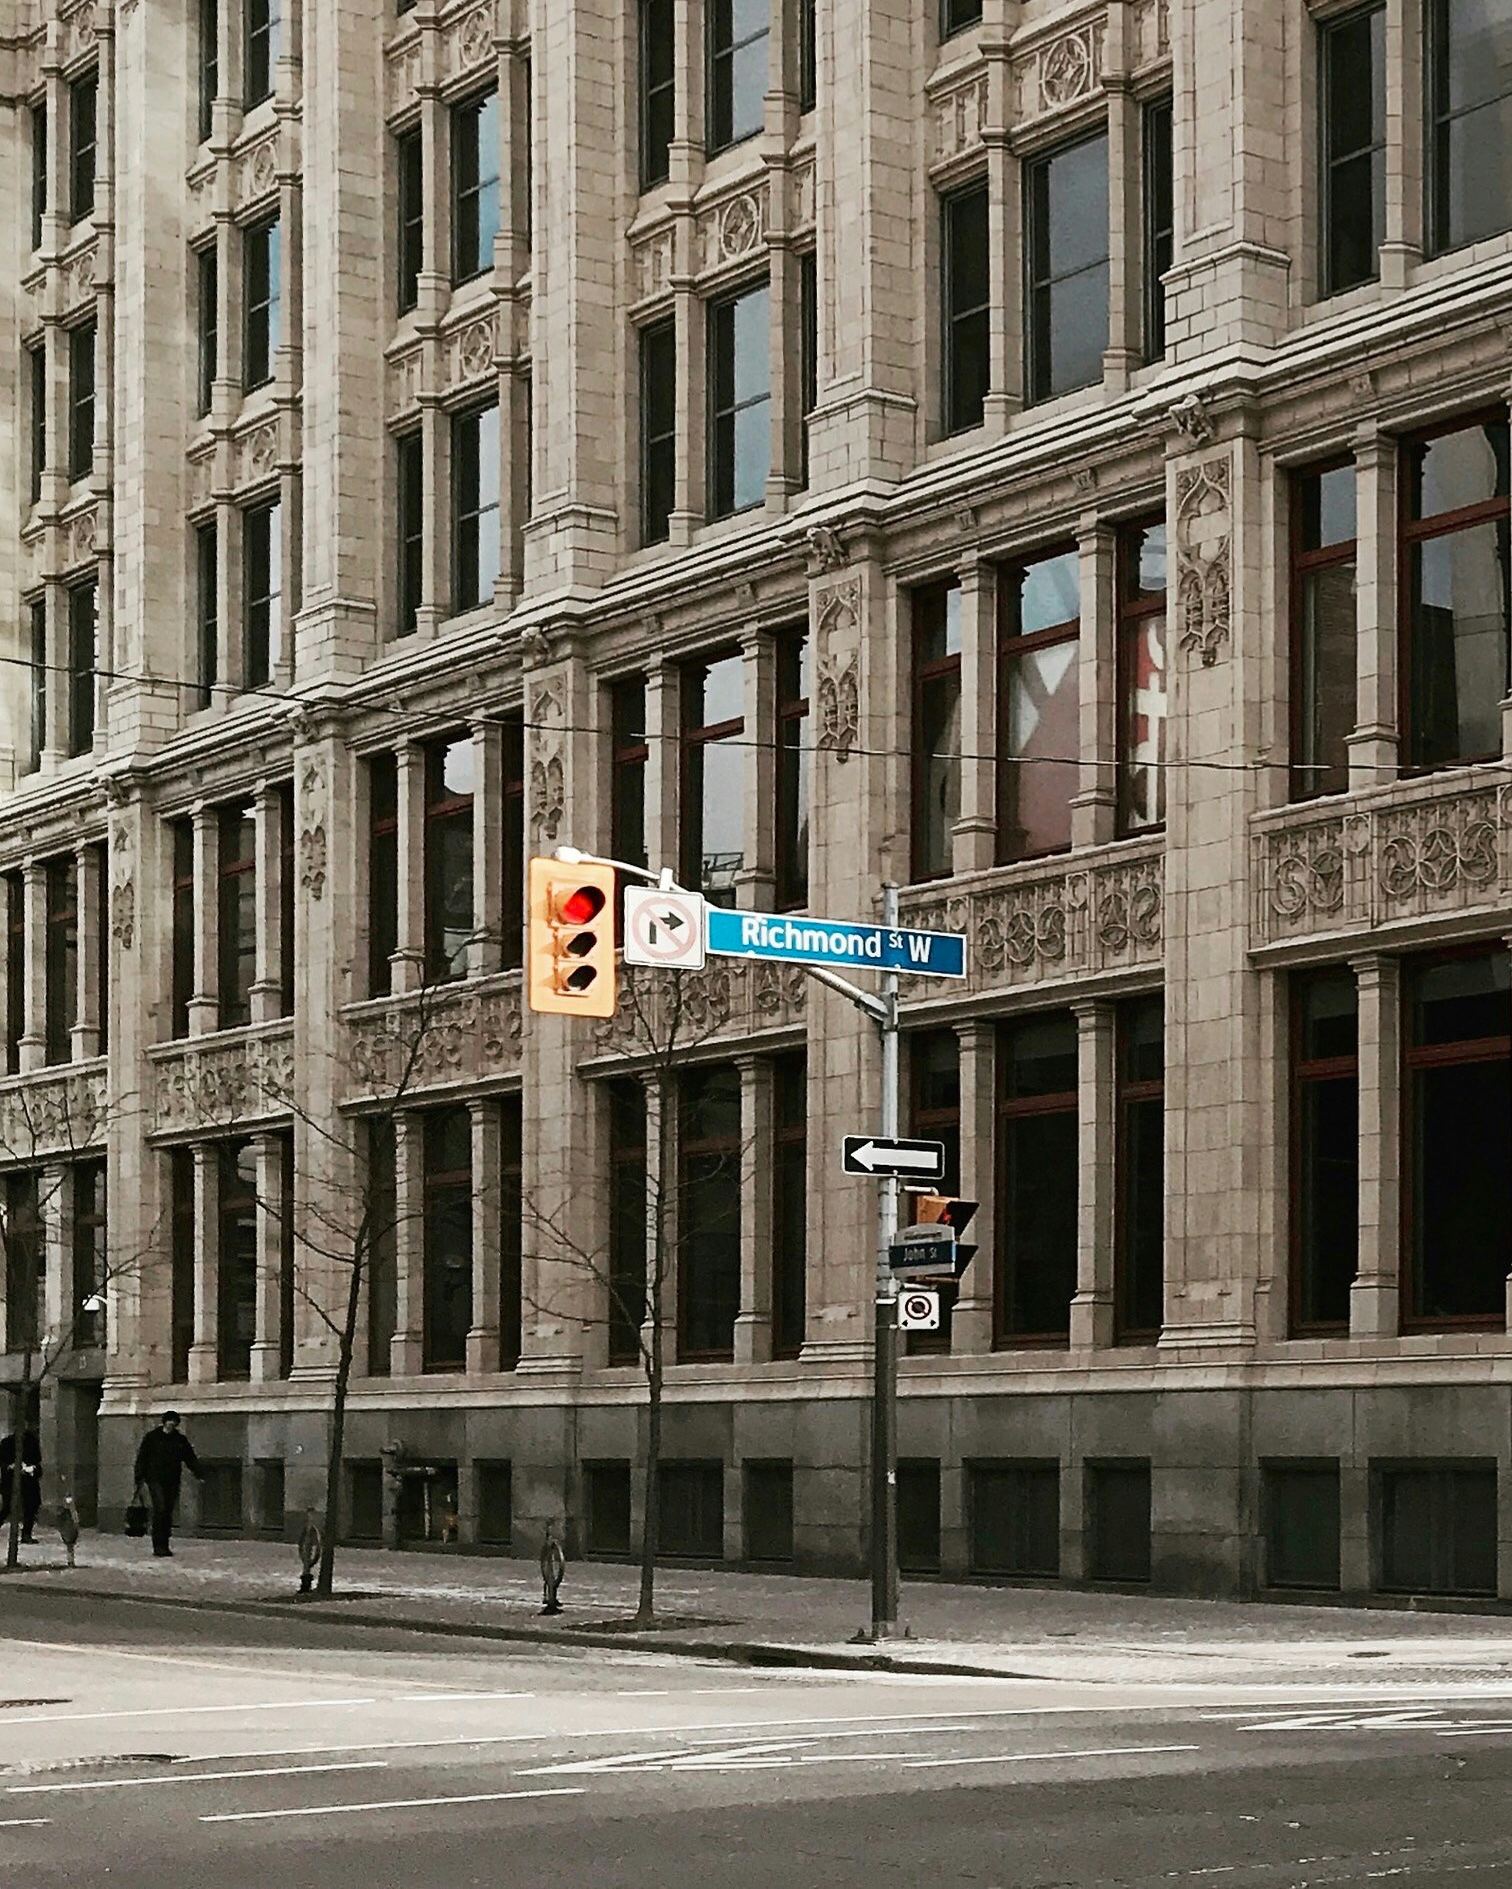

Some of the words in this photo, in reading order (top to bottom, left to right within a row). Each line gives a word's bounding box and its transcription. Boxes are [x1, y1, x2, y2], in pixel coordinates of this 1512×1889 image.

[741, 917, 881, 957] Richmond
[889, 933, 903, 949] St
[908, 935, 932, 963] W
[903, 1247, 925, 1261] John
